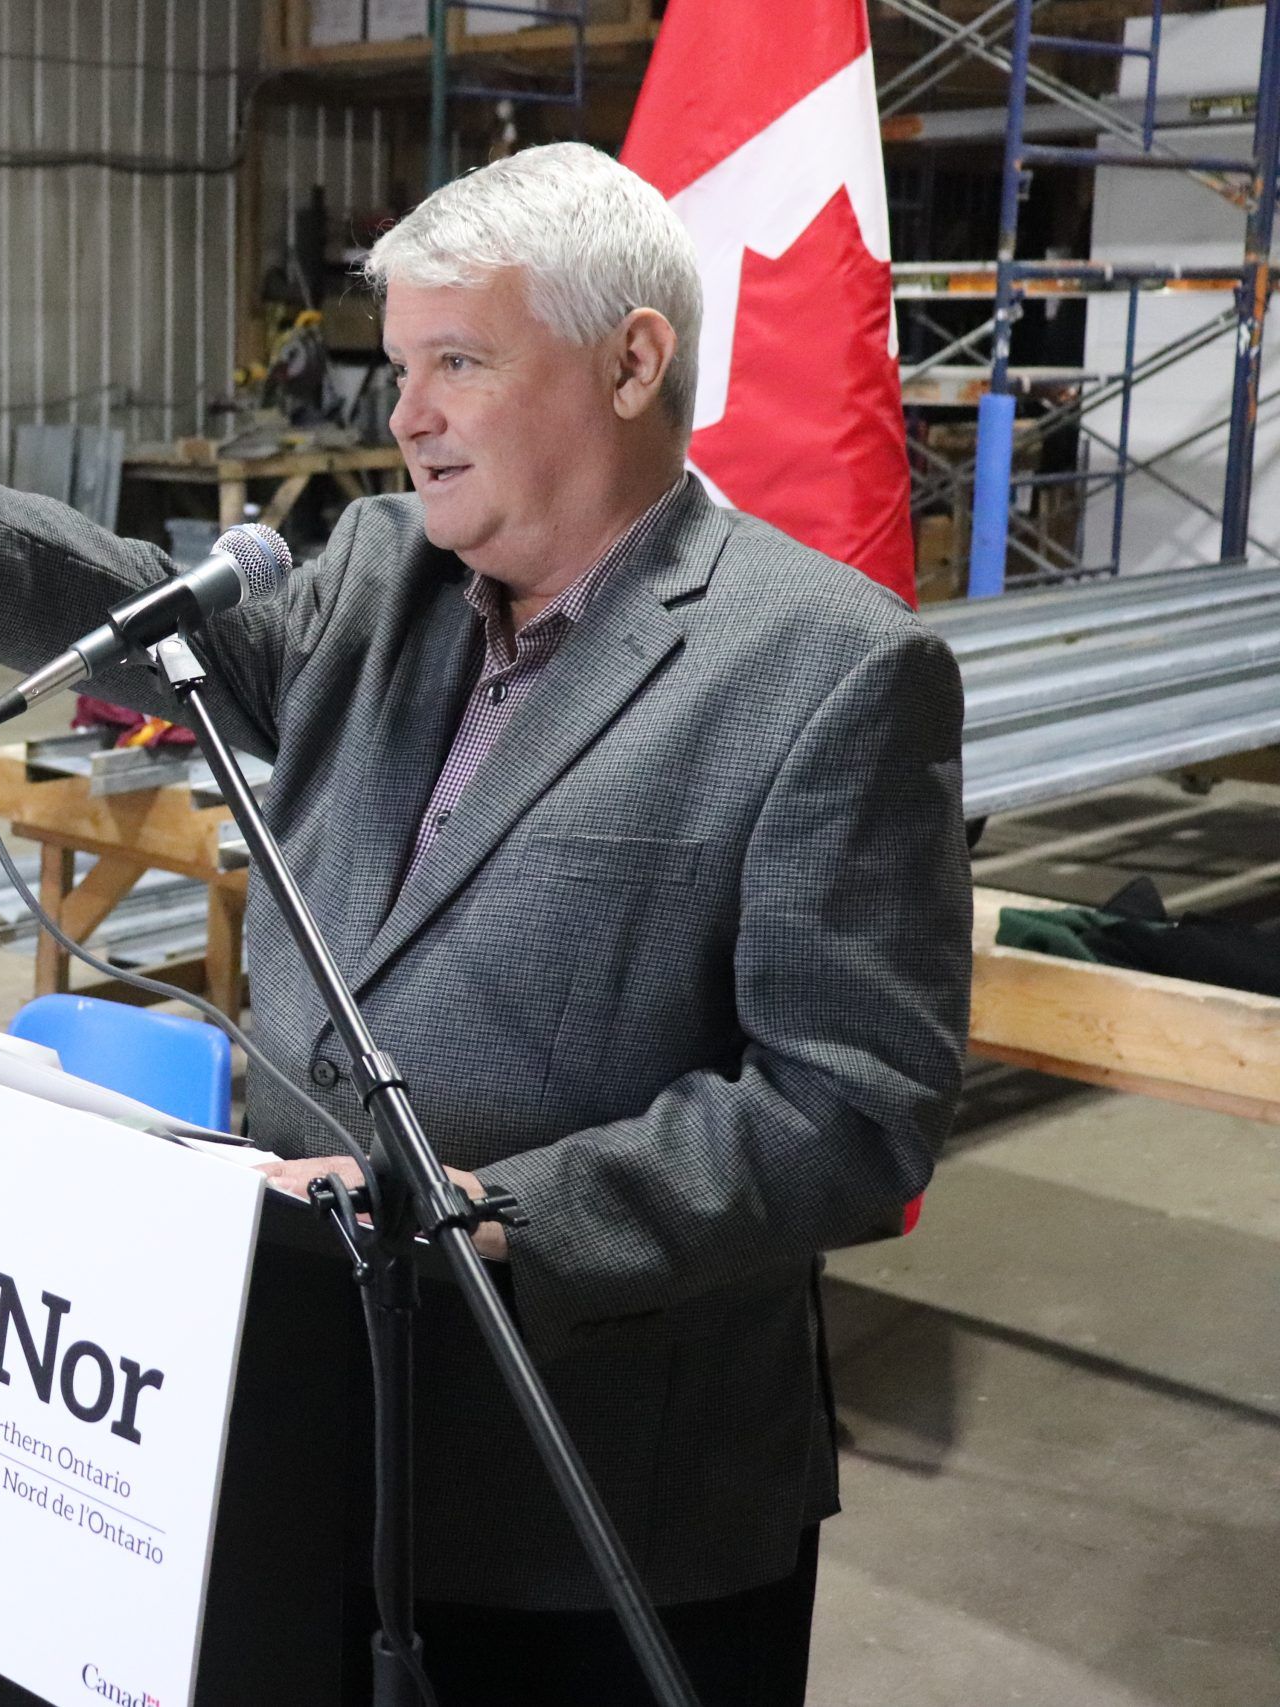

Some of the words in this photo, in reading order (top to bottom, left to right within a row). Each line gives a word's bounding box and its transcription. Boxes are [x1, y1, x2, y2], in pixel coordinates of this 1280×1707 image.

[57, 1446, 131, 1498] Ontario
[2, 1467, 47, 1509] Nord
[52, 1494, 75, 1522] de
[78, 1504, 164, 1565] l'Ontario
[81, 1663, 155, 1707] Canad
